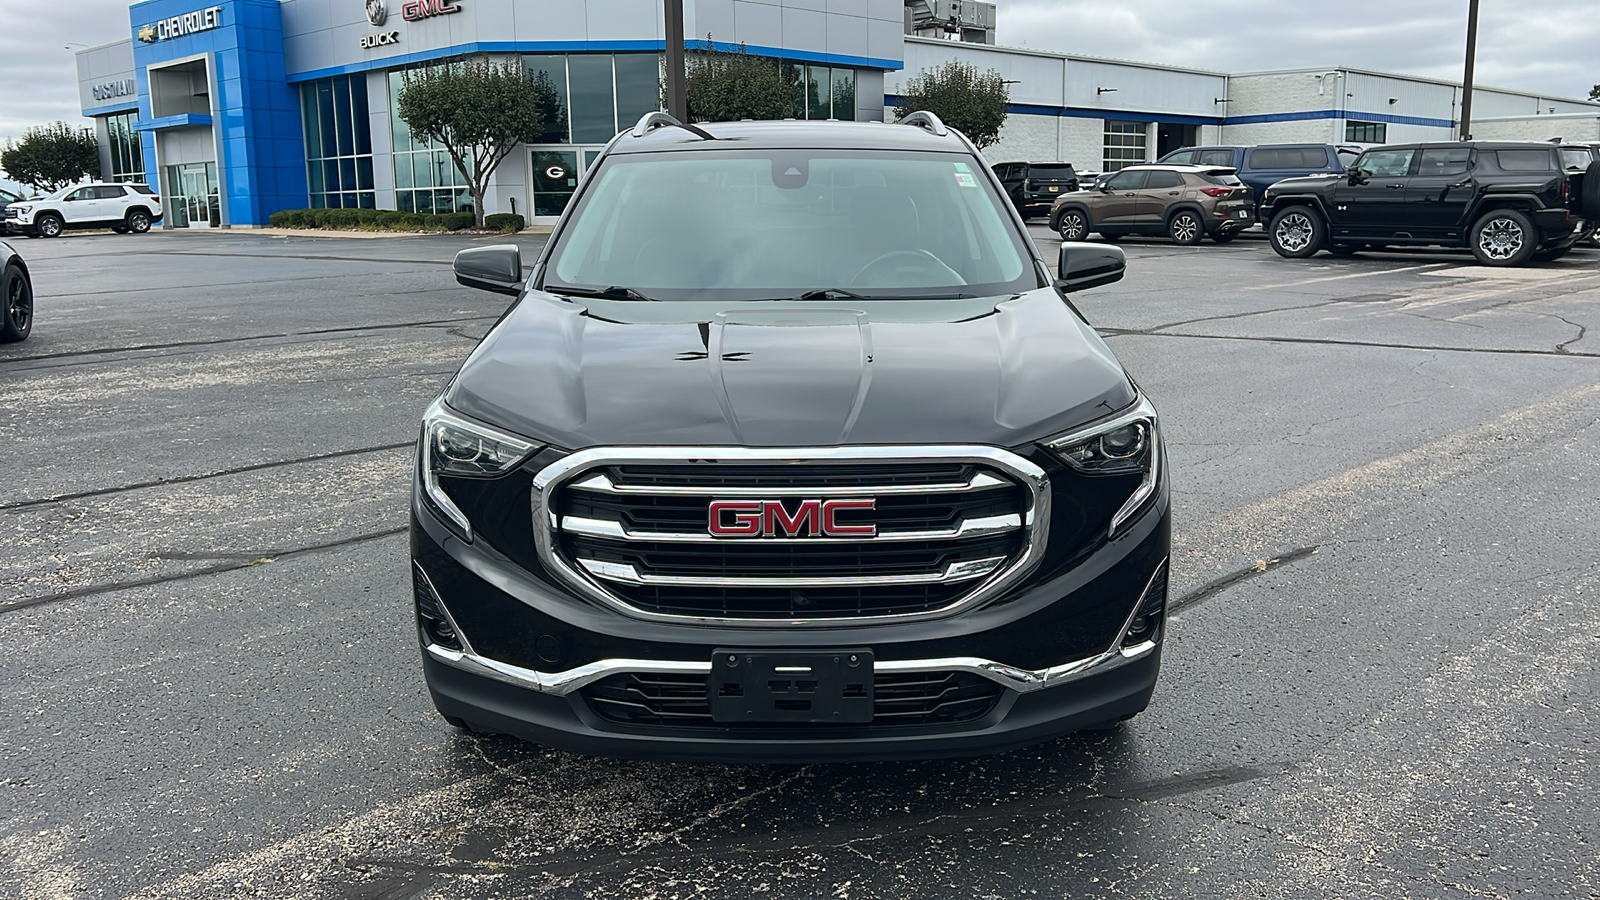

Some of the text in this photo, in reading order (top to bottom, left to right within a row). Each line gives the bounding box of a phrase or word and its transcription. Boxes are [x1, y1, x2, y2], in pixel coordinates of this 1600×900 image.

[402, 0, 458, 20] GMC
[157, 6, 221, 40] CHEVROLET
[360, 30, 397, 48] BUICK
[546, 166, 565, 179] G
[708, 499, 876, 537] GMC
